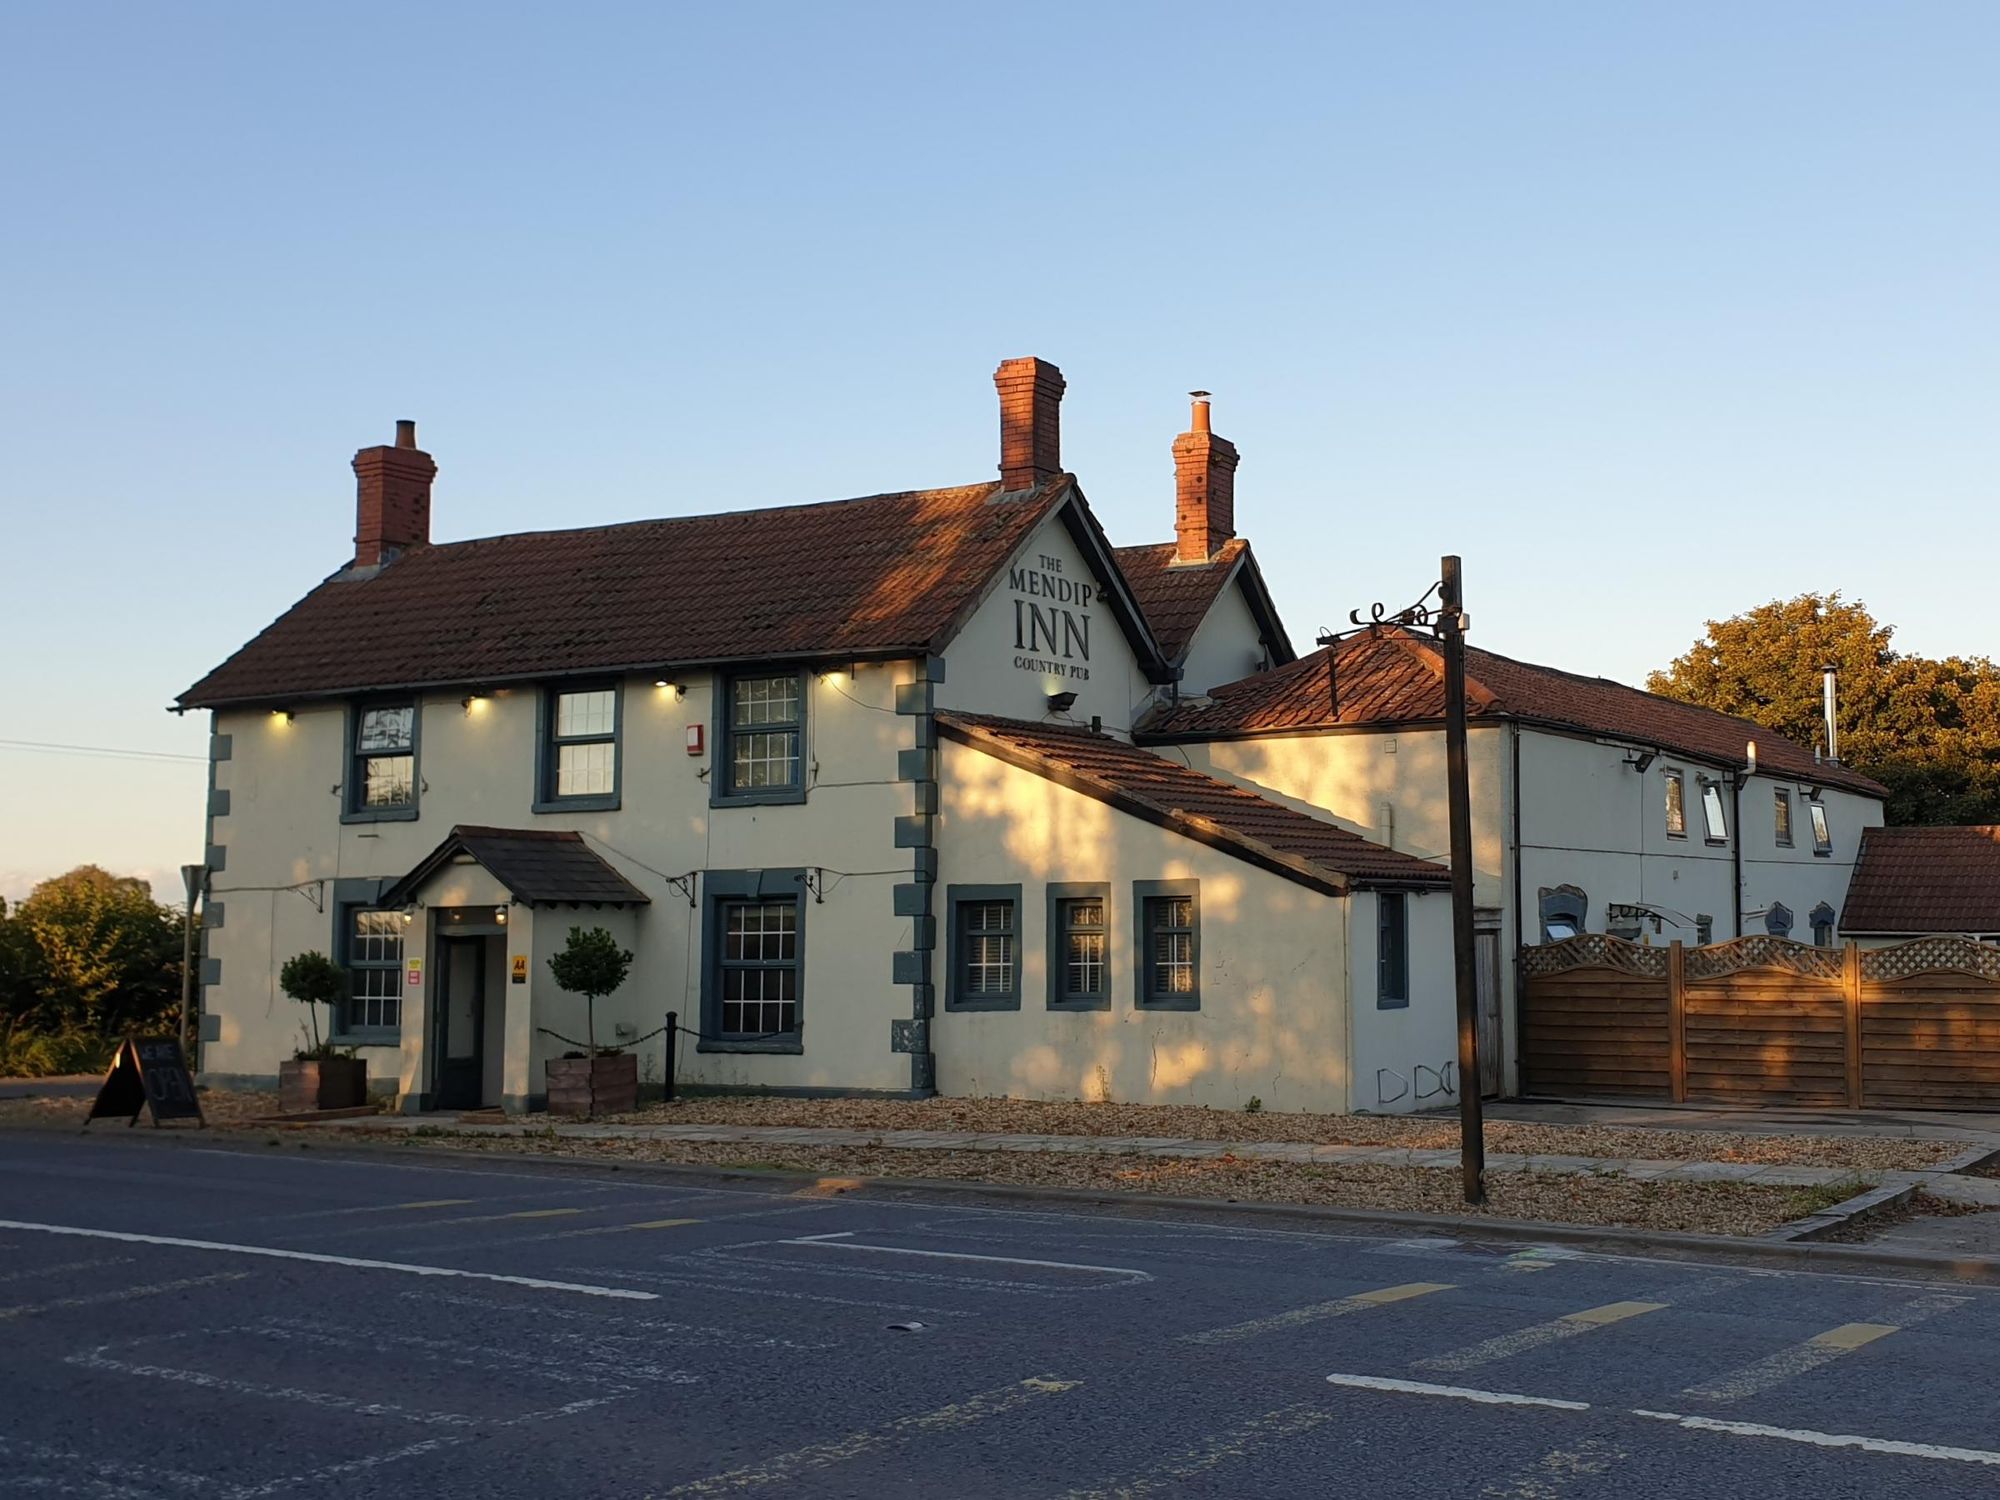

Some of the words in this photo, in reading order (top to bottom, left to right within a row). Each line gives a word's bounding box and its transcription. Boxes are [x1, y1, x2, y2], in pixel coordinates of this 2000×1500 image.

[1039, 554, 1062, 573] THE
[1009, 565, 1092, 607] MENDIP
[1014, 599, 1091, 662] INN
[1014, 655, 1067, 677] COUNTRY
[1070, 665, 1090, 681] PUB
